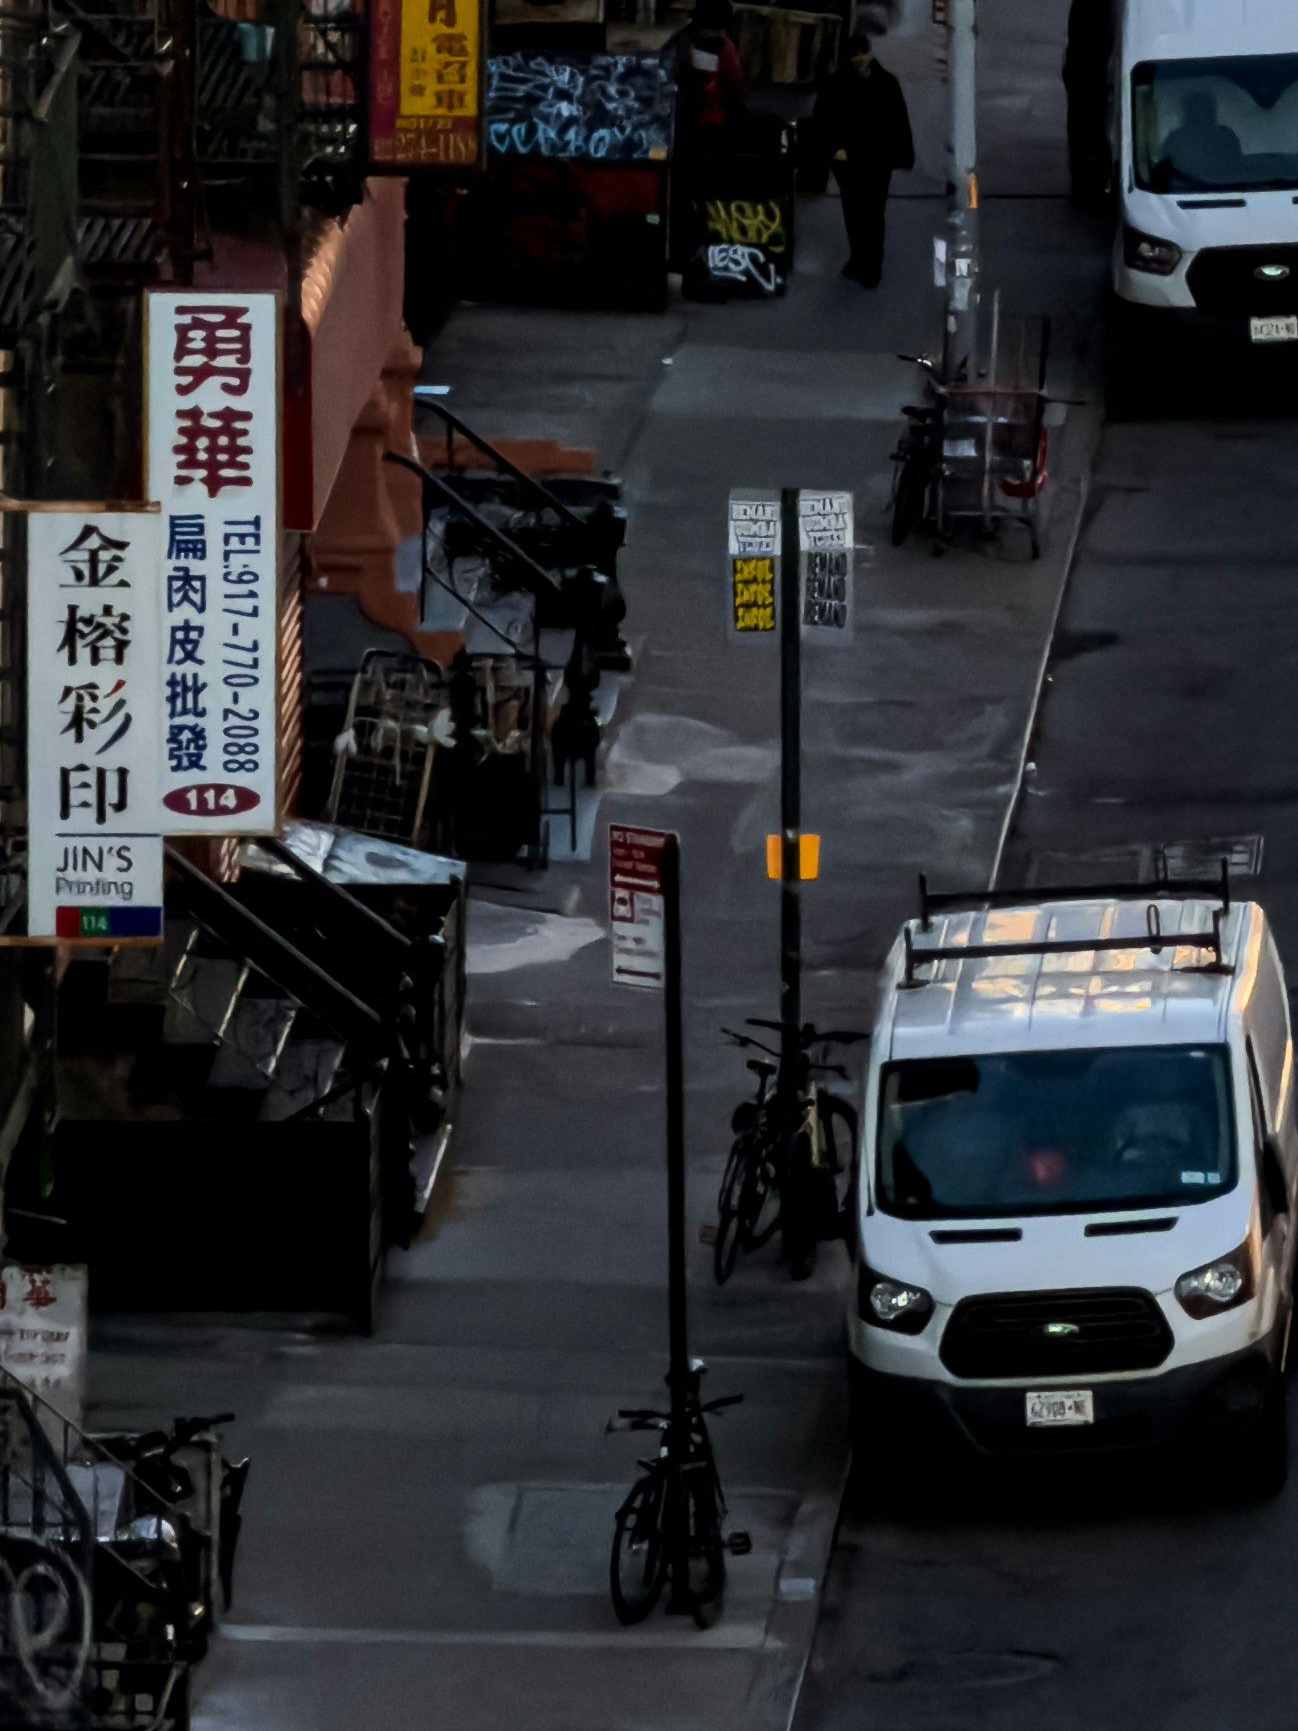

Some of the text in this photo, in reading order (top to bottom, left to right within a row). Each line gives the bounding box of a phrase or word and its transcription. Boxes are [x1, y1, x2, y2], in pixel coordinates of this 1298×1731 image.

[171, 304, 255, 499] 勇華
[55, 522, 133, 826] 金榕彩印
[165, 513, 208, 774] 扁肉皮批發
[221, 514, 262, 774] TEL:917-770-2088
[54, 877, 134, 902] Printing
[55, 845, 133, 874] JIN'S
[184, 787, 240, 812] 114
